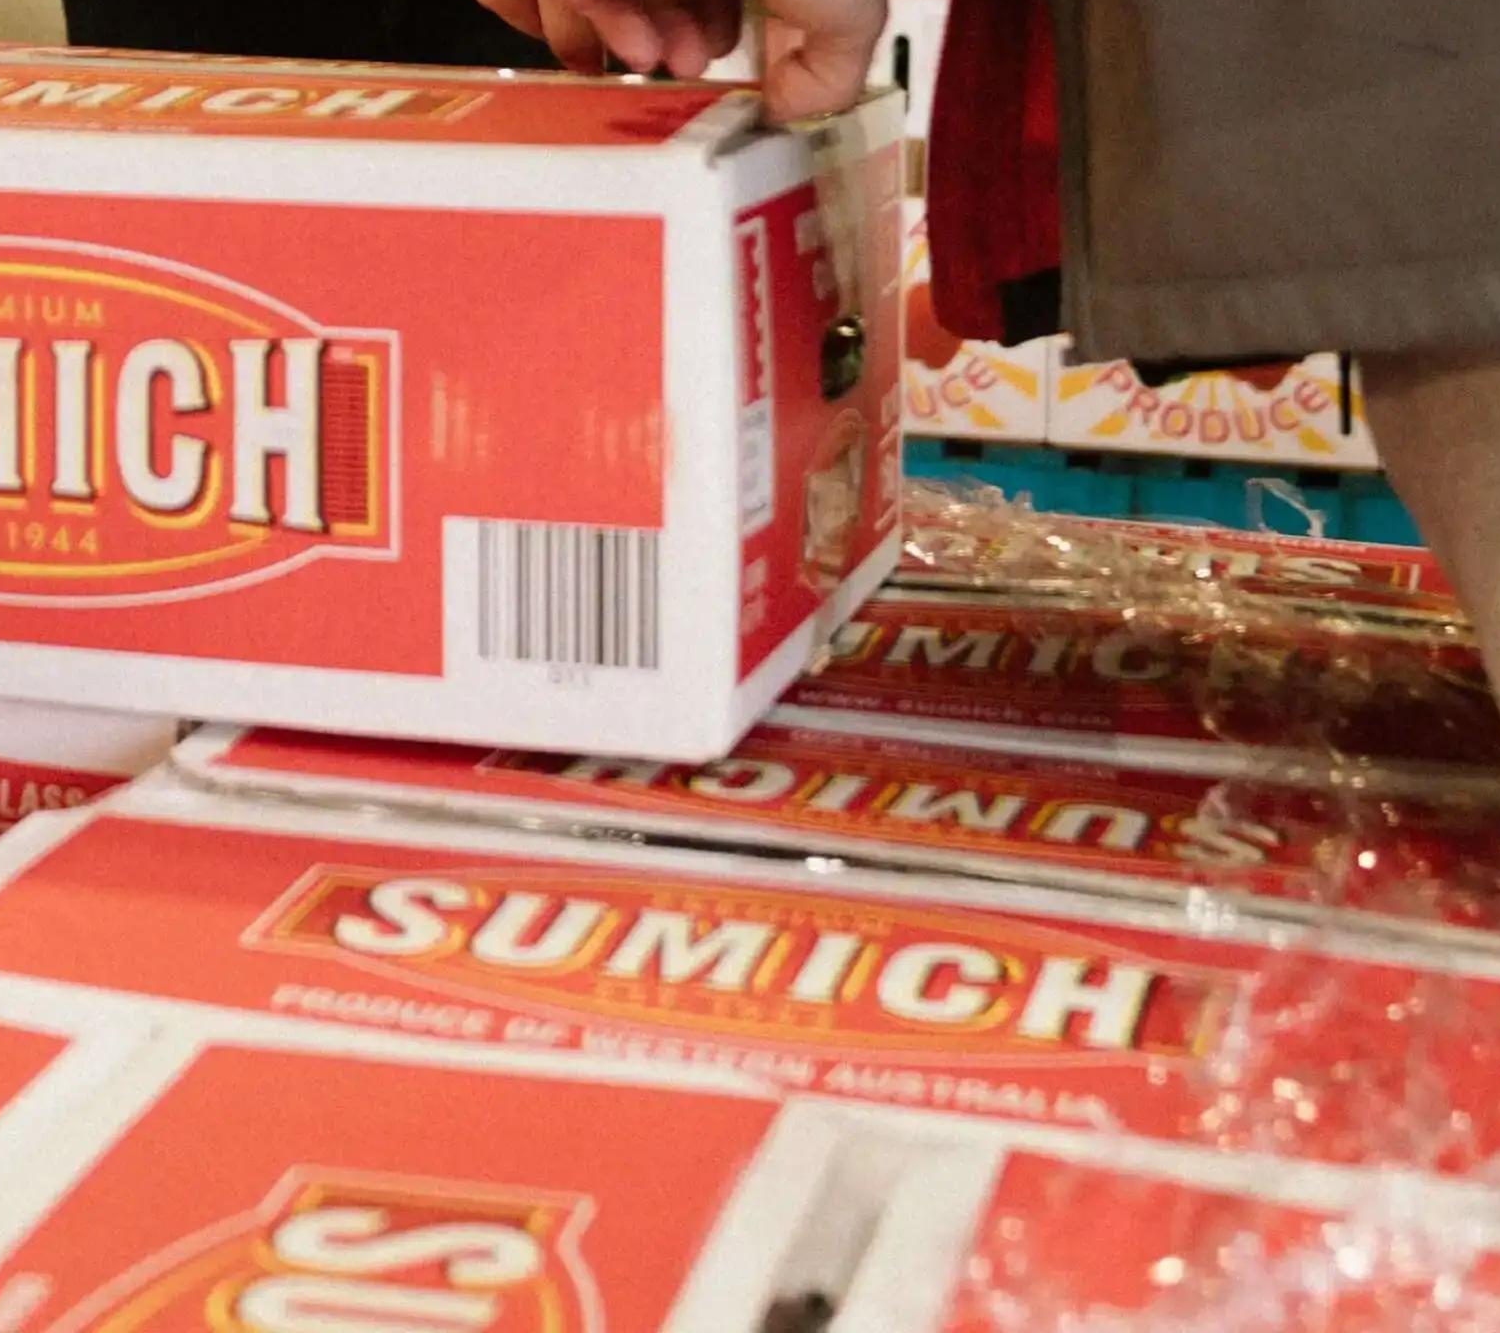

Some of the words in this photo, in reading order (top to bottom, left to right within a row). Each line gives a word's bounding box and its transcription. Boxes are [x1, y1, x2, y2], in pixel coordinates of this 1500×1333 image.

[1095, 359, 1333, 445] PRODUCE
[333, 877, 1154, 1049] SUMICH
[269, 983, 492, 1039] PRODUCE
[503, 1014, 570, 1049] OF
[825, 1060, 1121, 1120] AUSTRALIA
